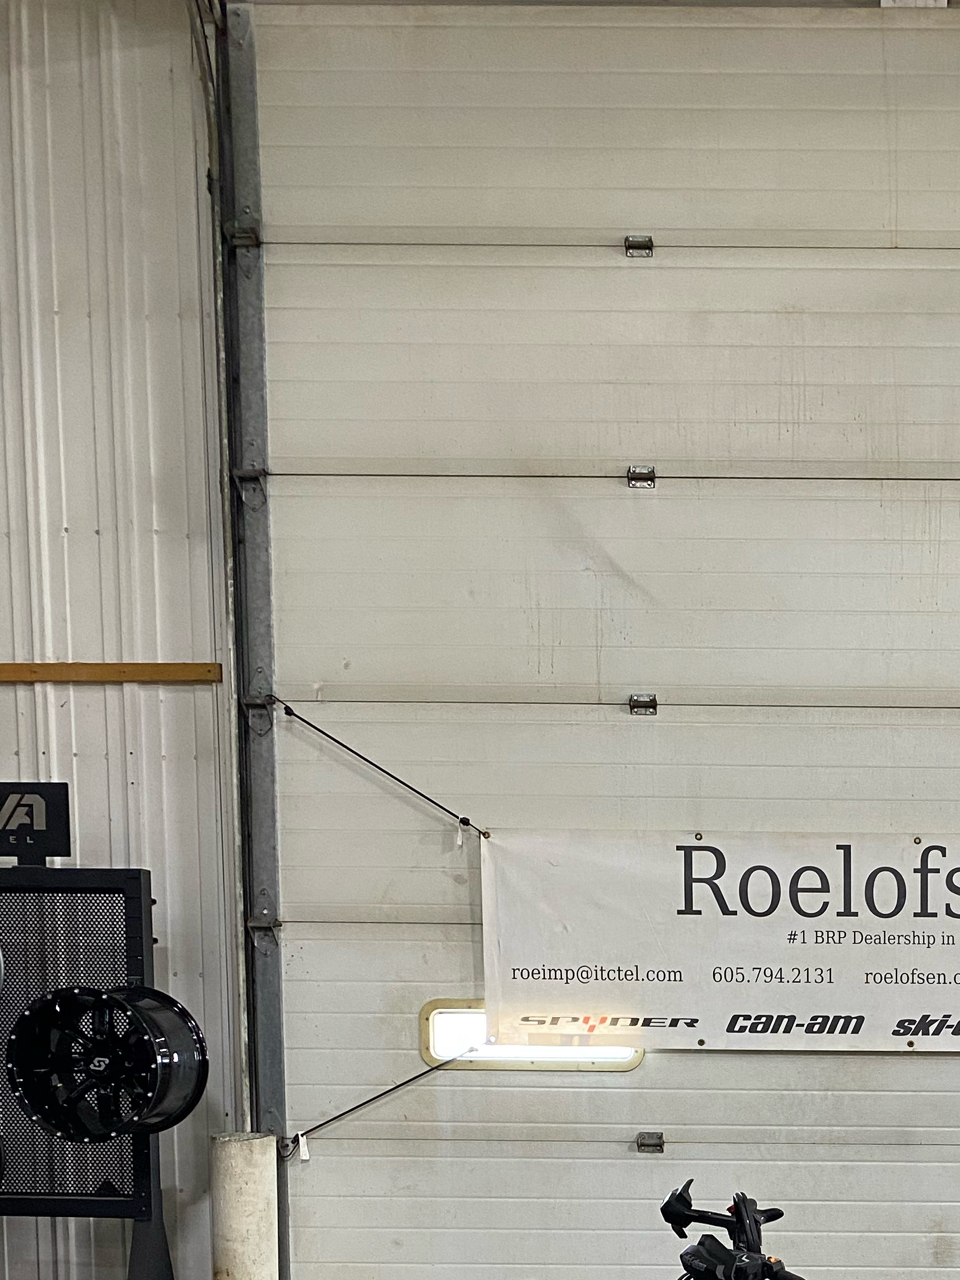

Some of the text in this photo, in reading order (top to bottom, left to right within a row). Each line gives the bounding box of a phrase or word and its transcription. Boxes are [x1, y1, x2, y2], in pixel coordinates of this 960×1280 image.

[787, 930, 806, 945] #1
[815, 930, 846, 945] BRP
[852, 930, 935, 949] Dealership
[941, 931, 955, 945] in
[511, 964, 683, 985] roeimp@itctel.com
[712, 966, 835, 984] 605.794.2131
[519, 1015, 699, 1032] SPYDER
